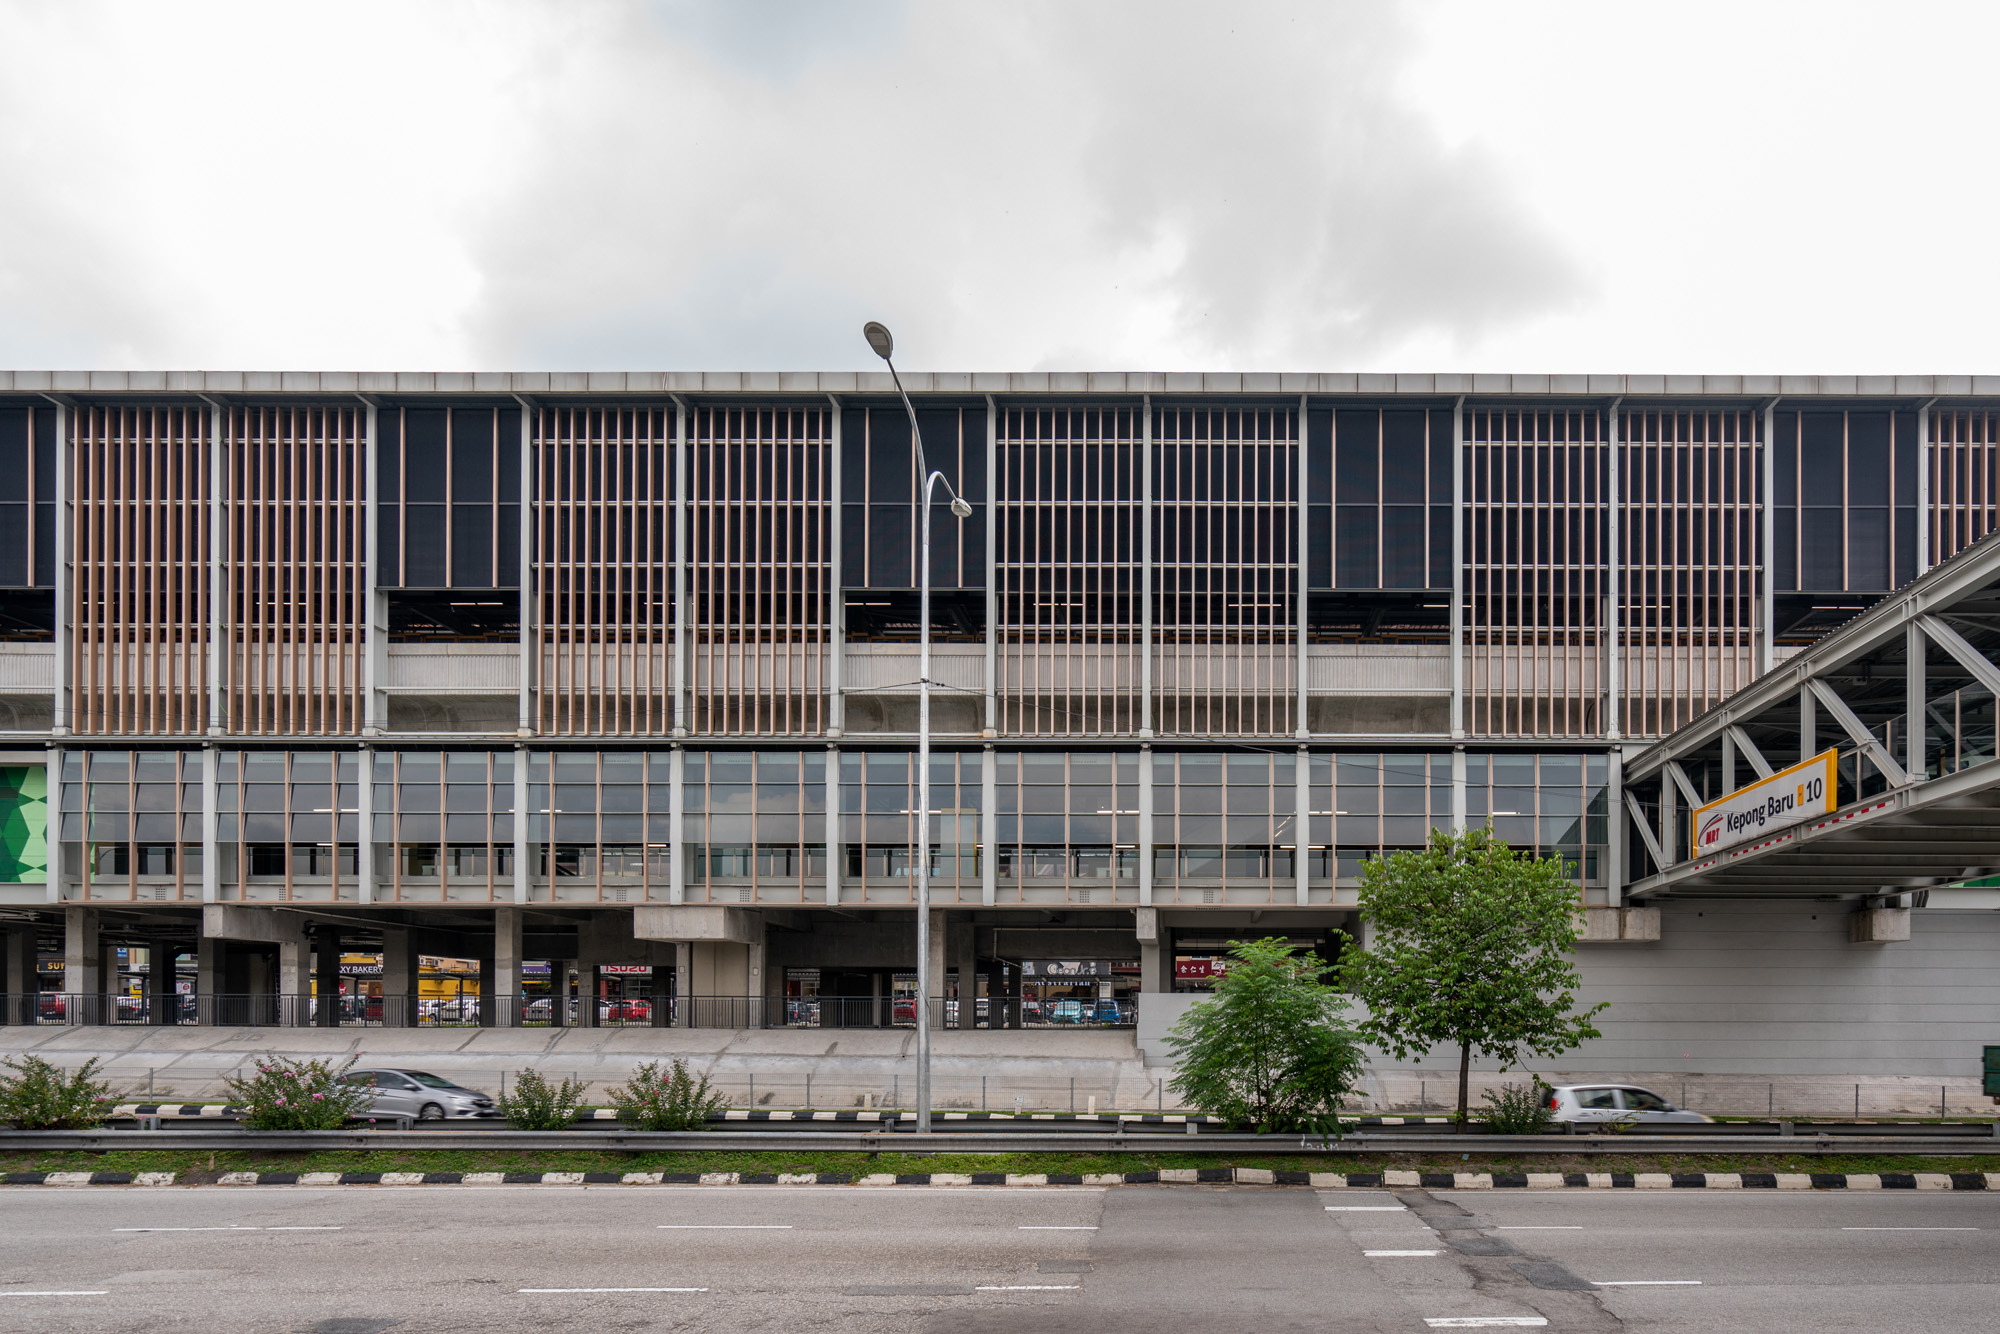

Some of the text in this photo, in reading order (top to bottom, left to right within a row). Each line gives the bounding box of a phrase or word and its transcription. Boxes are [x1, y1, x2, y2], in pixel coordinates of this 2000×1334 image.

[1727, 778, 1822, 834] Kepong Baru 10
[1705, 827, 1720, 845] MRT
[352, 965, 383, 973] BAKERY
